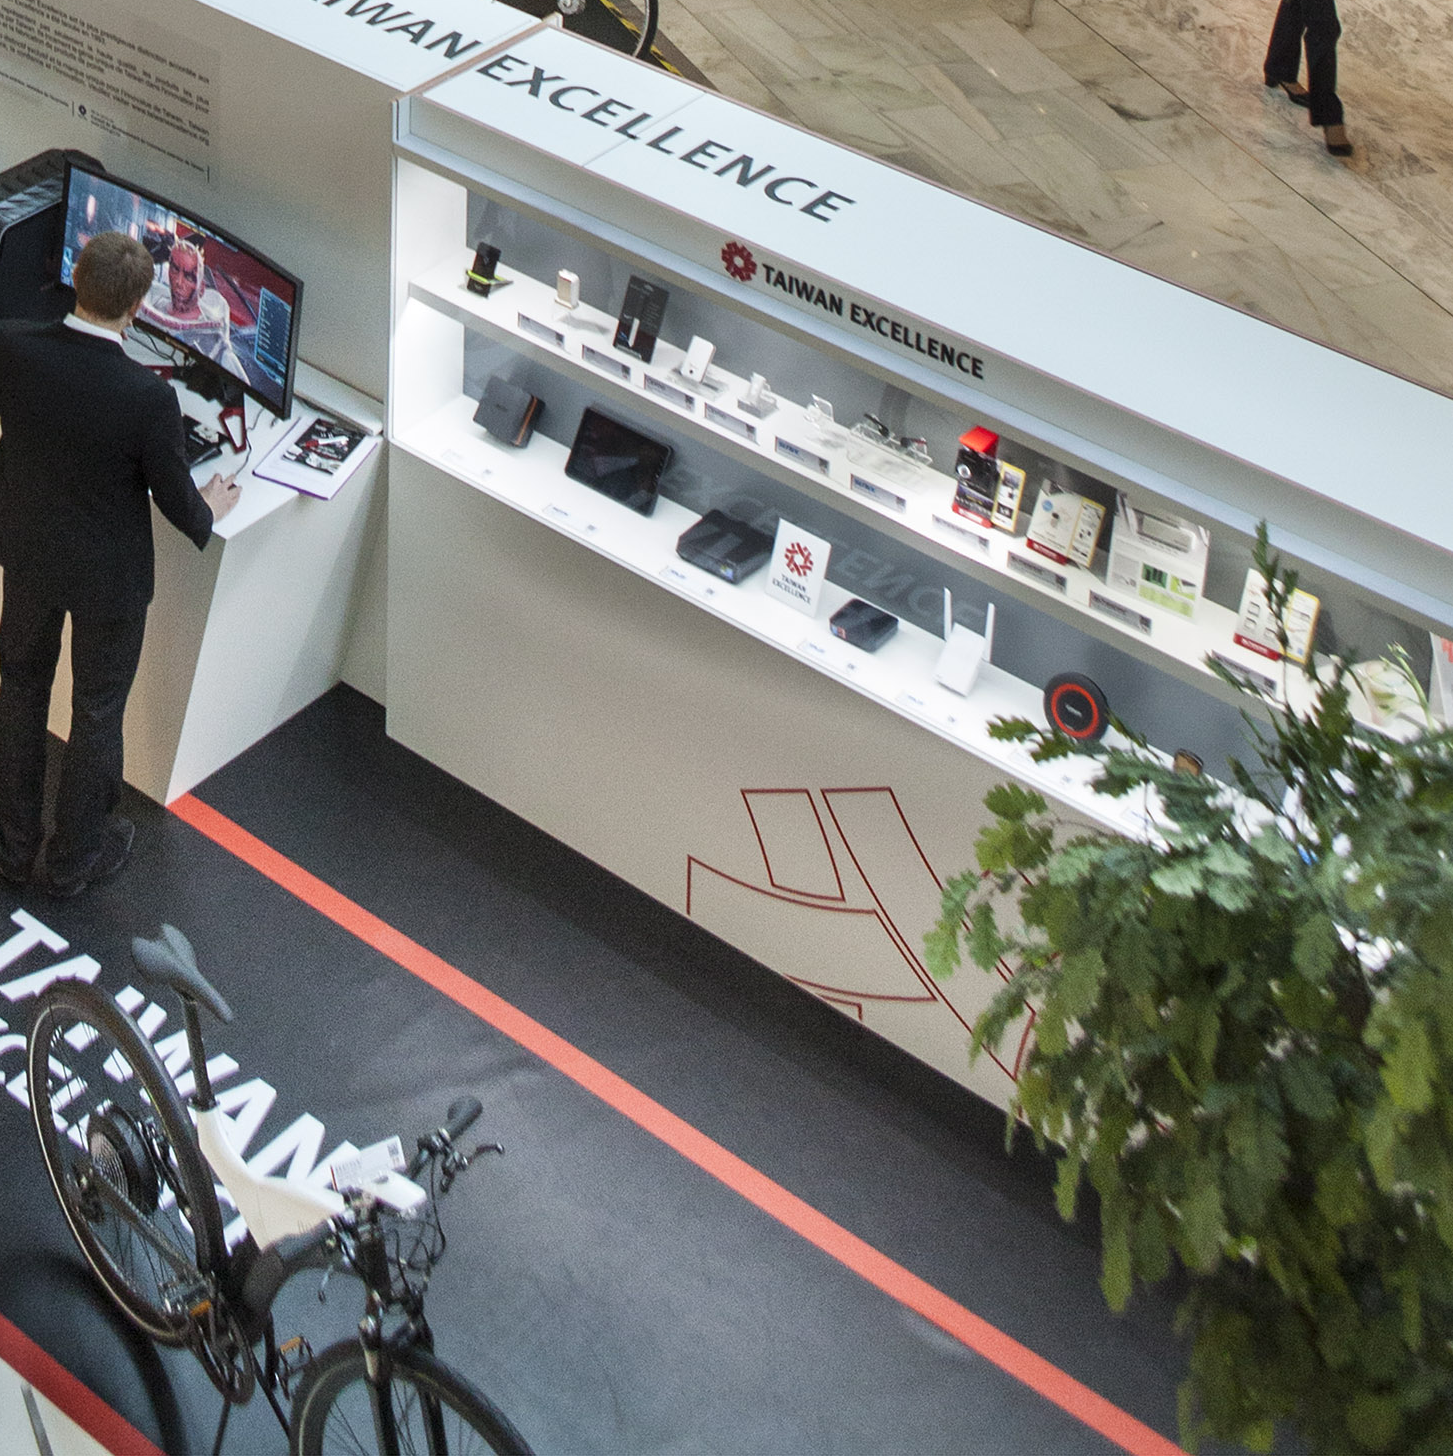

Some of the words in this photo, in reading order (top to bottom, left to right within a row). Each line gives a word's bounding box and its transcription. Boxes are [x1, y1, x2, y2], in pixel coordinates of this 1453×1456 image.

[475, 53, 856, 223] EXCELLENCE
[762, 263, 843, 317] TAIWAN
[850, 302, 985, 381] EXCELLENCE
